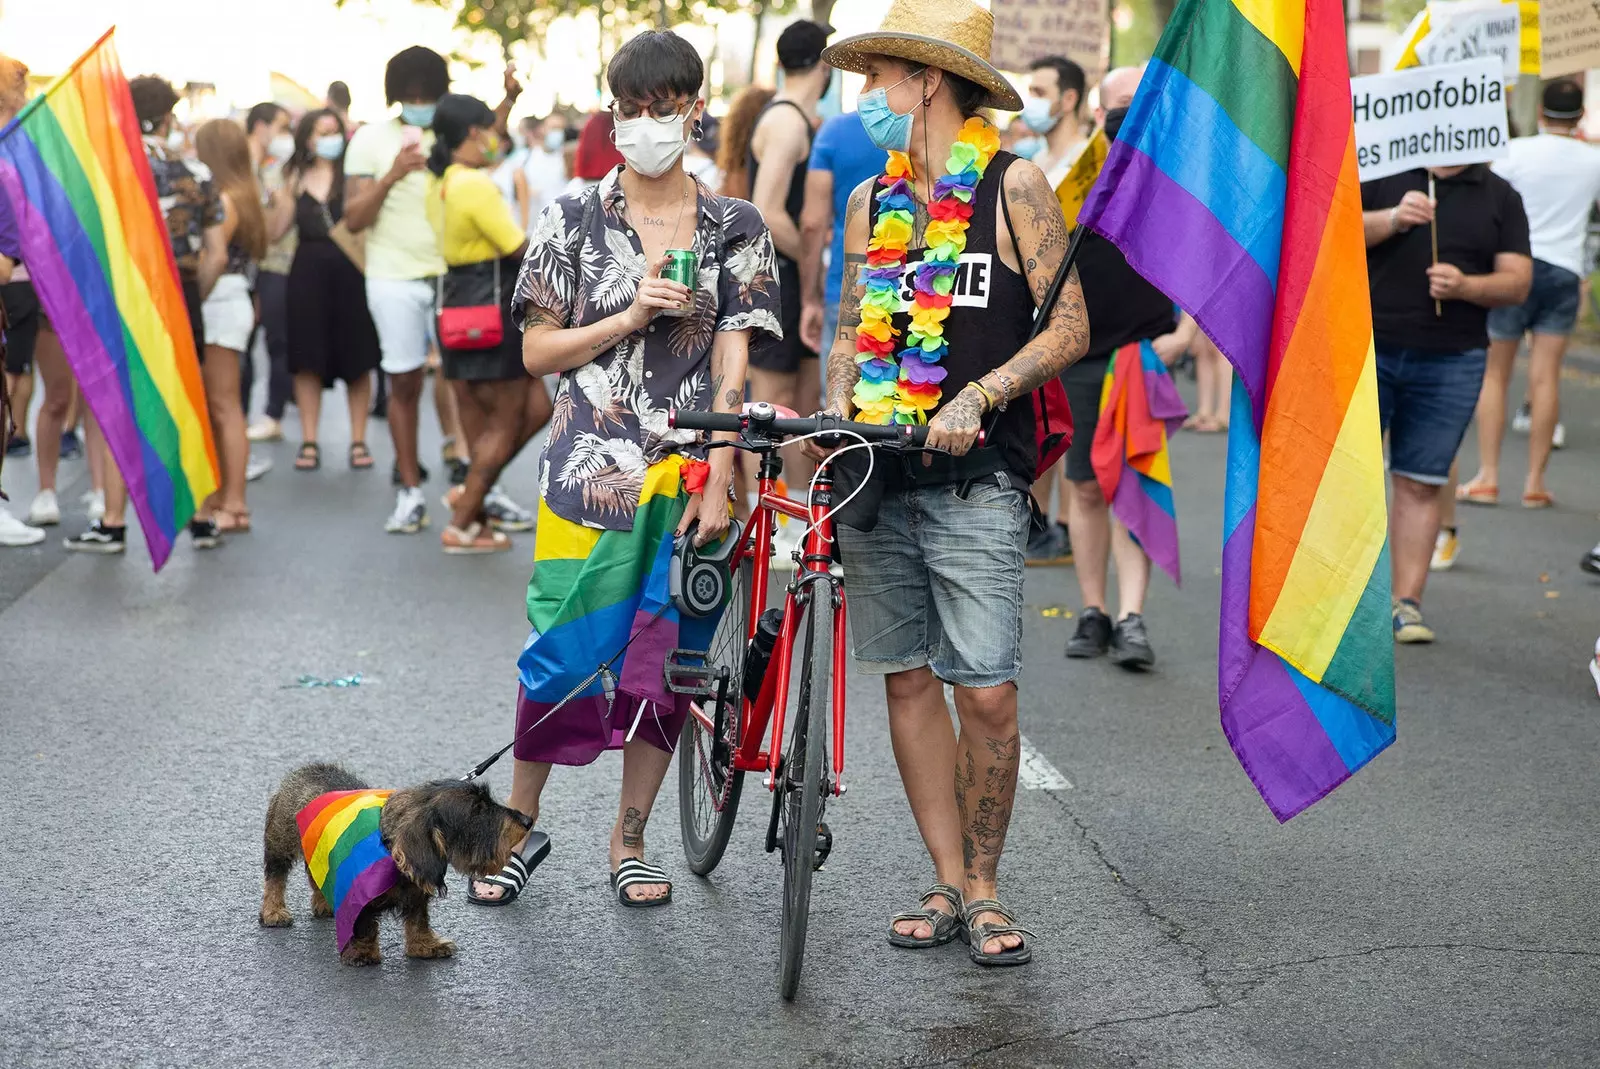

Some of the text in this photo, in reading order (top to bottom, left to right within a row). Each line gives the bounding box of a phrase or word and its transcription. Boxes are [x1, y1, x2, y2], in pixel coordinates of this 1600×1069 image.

[1353, 74, 1501, 123] Homofobia
[1357, 123, 1507, 168] es machismo.
[899, 262, 987, 302] SME
